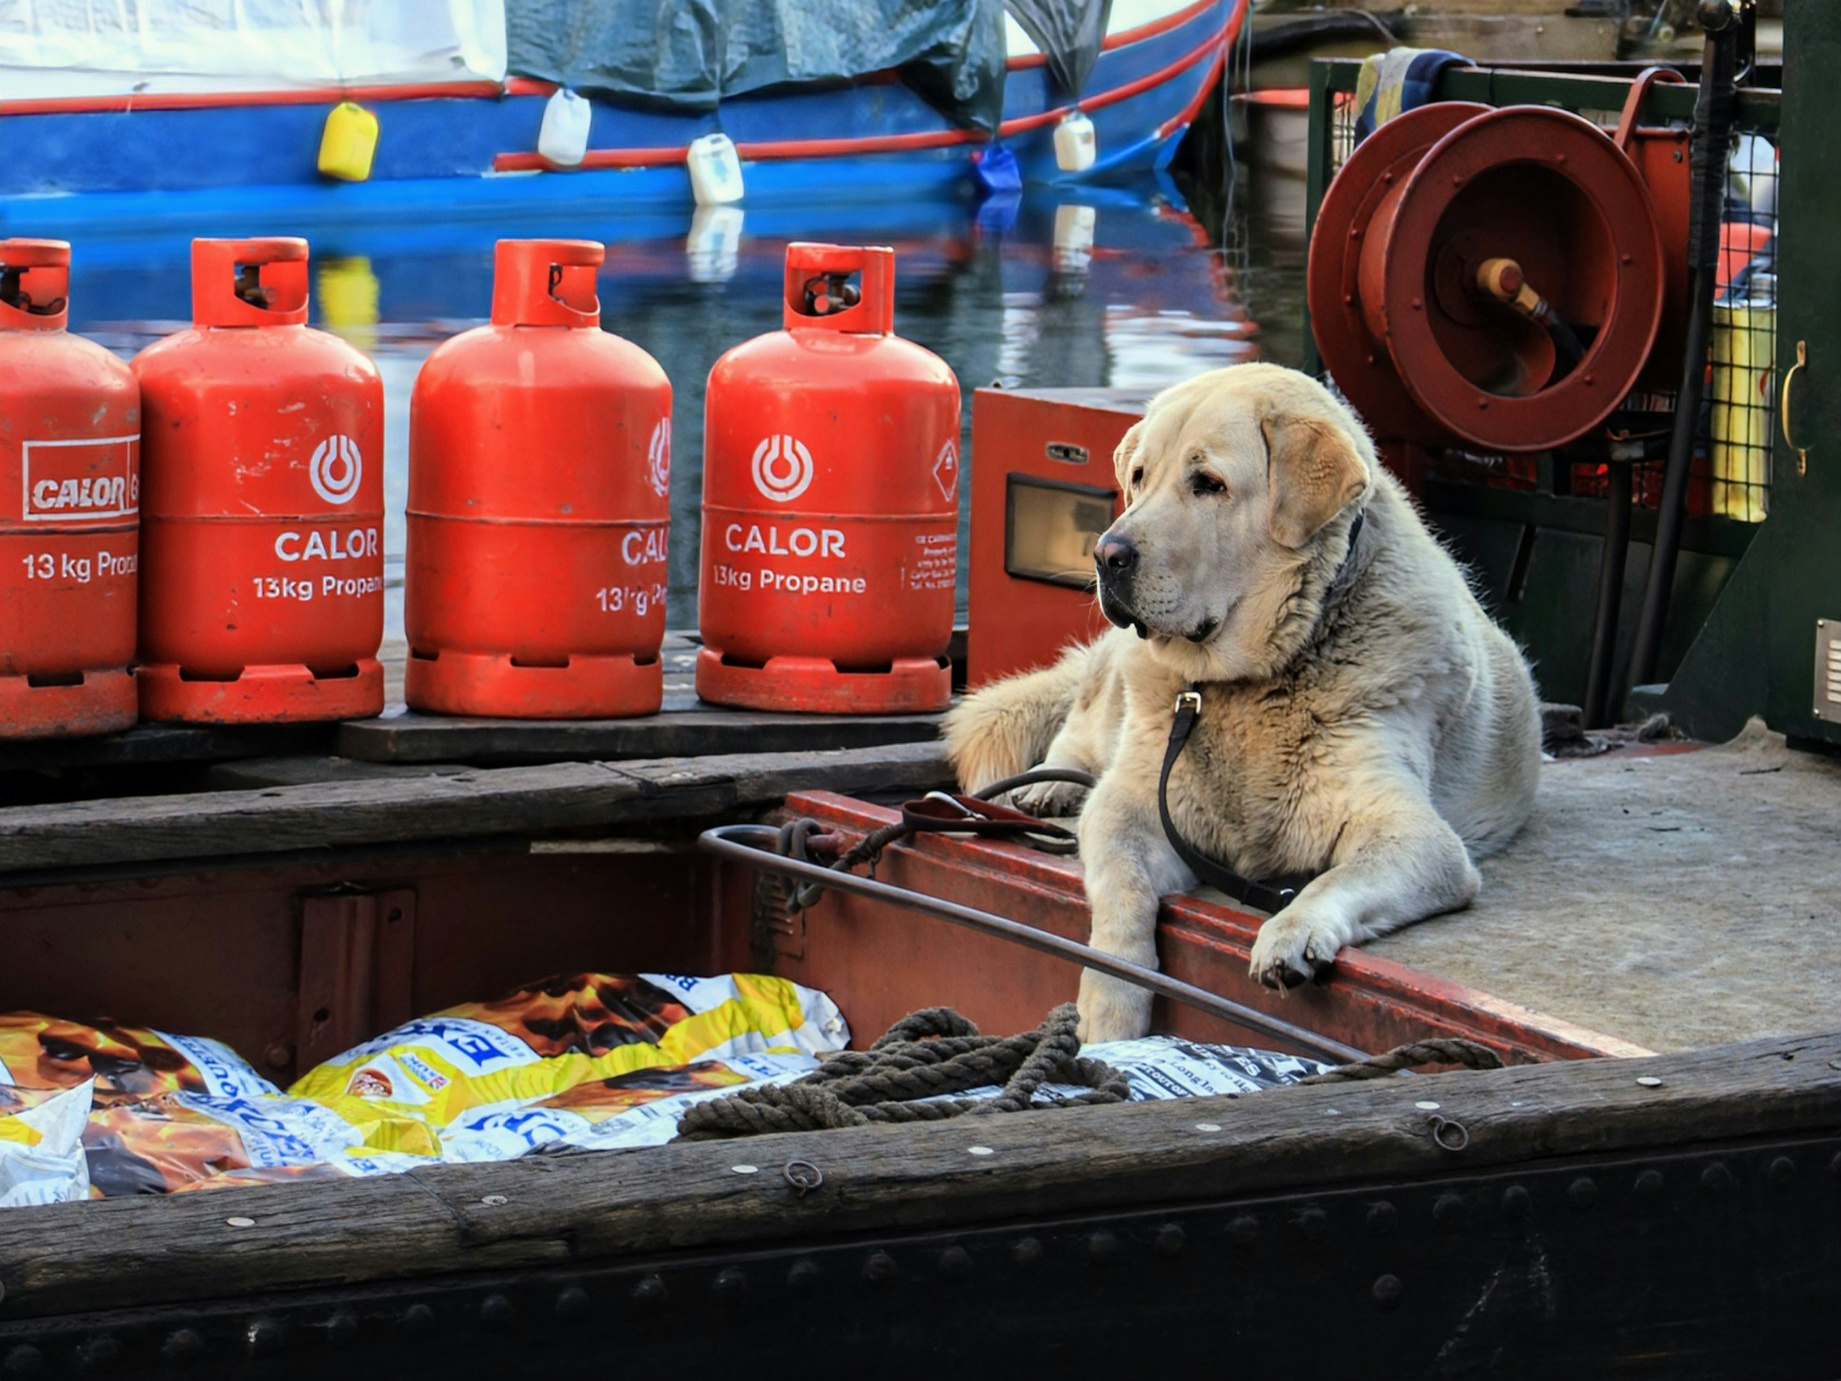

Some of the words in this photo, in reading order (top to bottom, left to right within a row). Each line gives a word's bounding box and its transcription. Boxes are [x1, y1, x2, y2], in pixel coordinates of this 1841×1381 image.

[33, 477, 125, 512] CALOR
[275, 528, 377, 561] CALOR
[725, 524, 845, 558] CALOR
[23, 553, 54, 578] 13
[62, 553, 91, 583] kg
[714, 565, 751, 590] 13kg
[760, 569, 866, 595] Propane
[254, 577, 313, 601] 13kg
